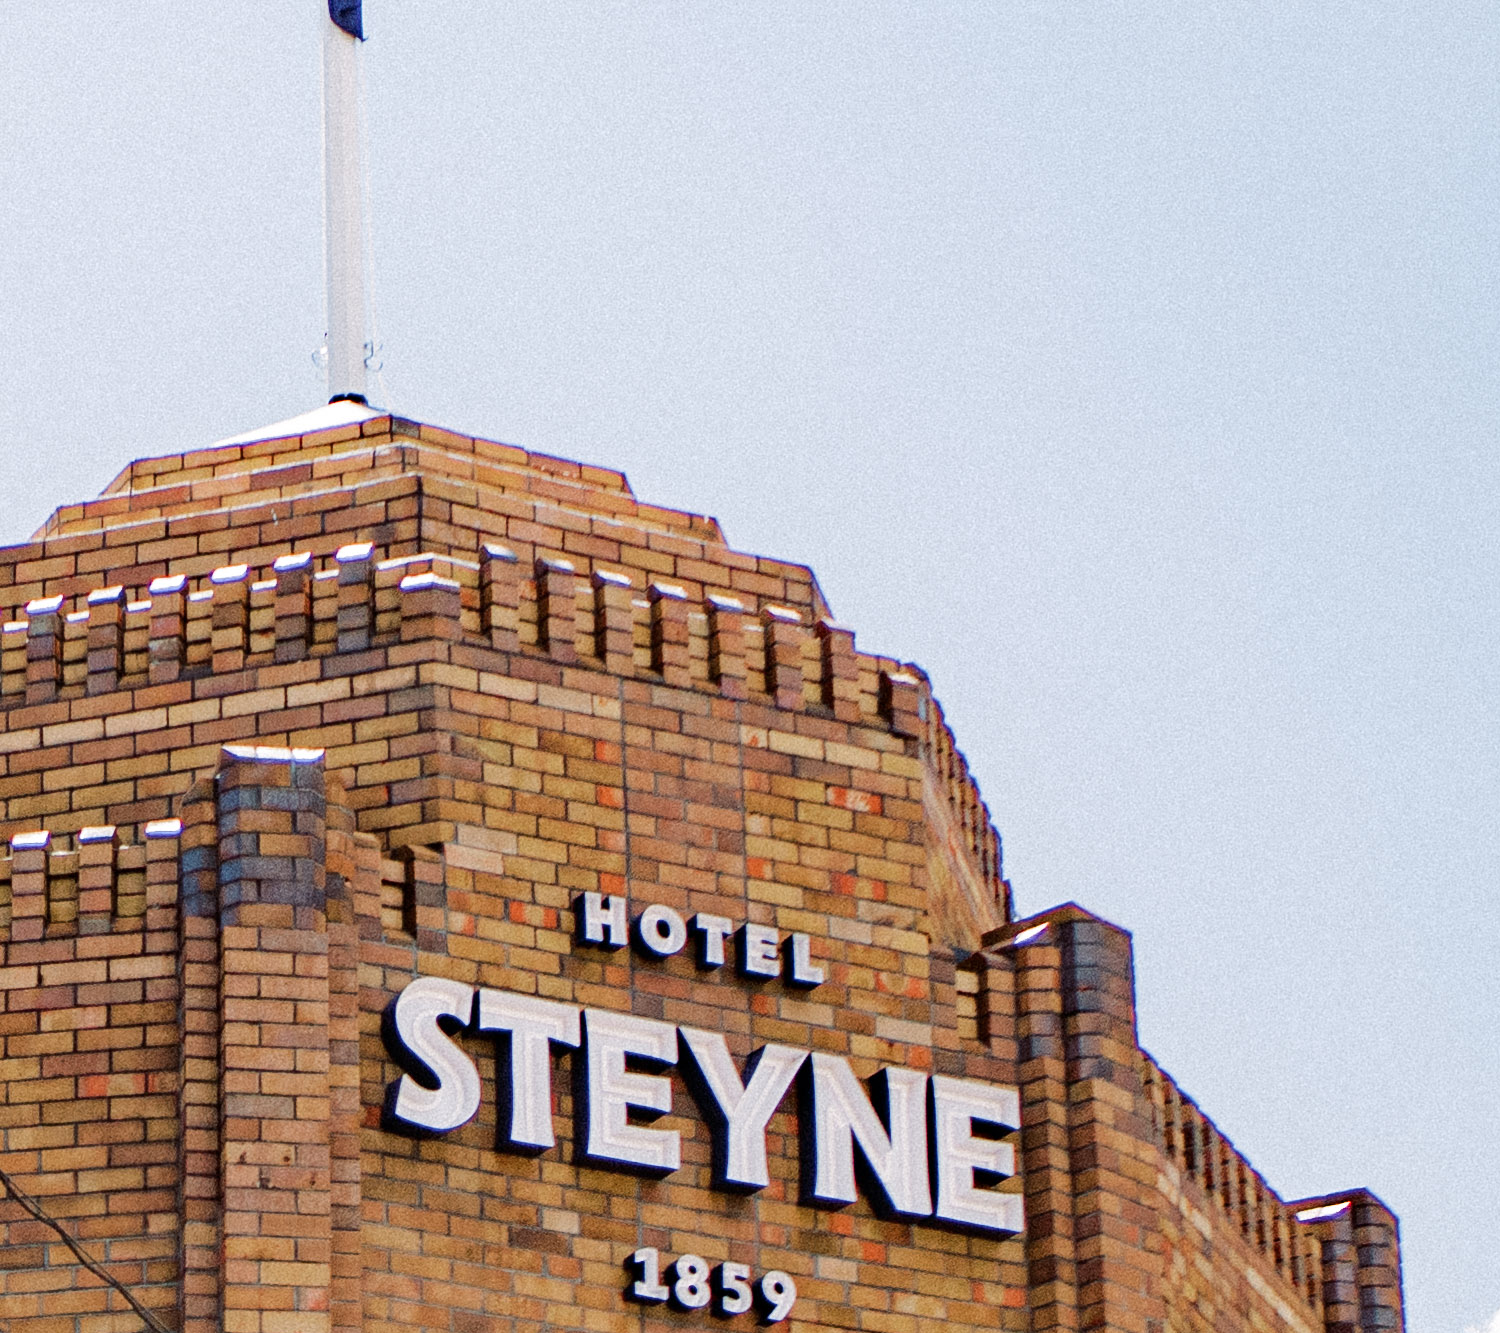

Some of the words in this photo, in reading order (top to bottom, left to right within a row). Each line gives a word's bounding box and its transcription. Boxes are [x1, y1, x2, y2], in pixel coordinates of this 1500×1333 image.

[579, 891, 824, 986] HOTEL
[388, 975, 1025, 1234] STEYNE
[630, 1247, 797, 1323] 1859
